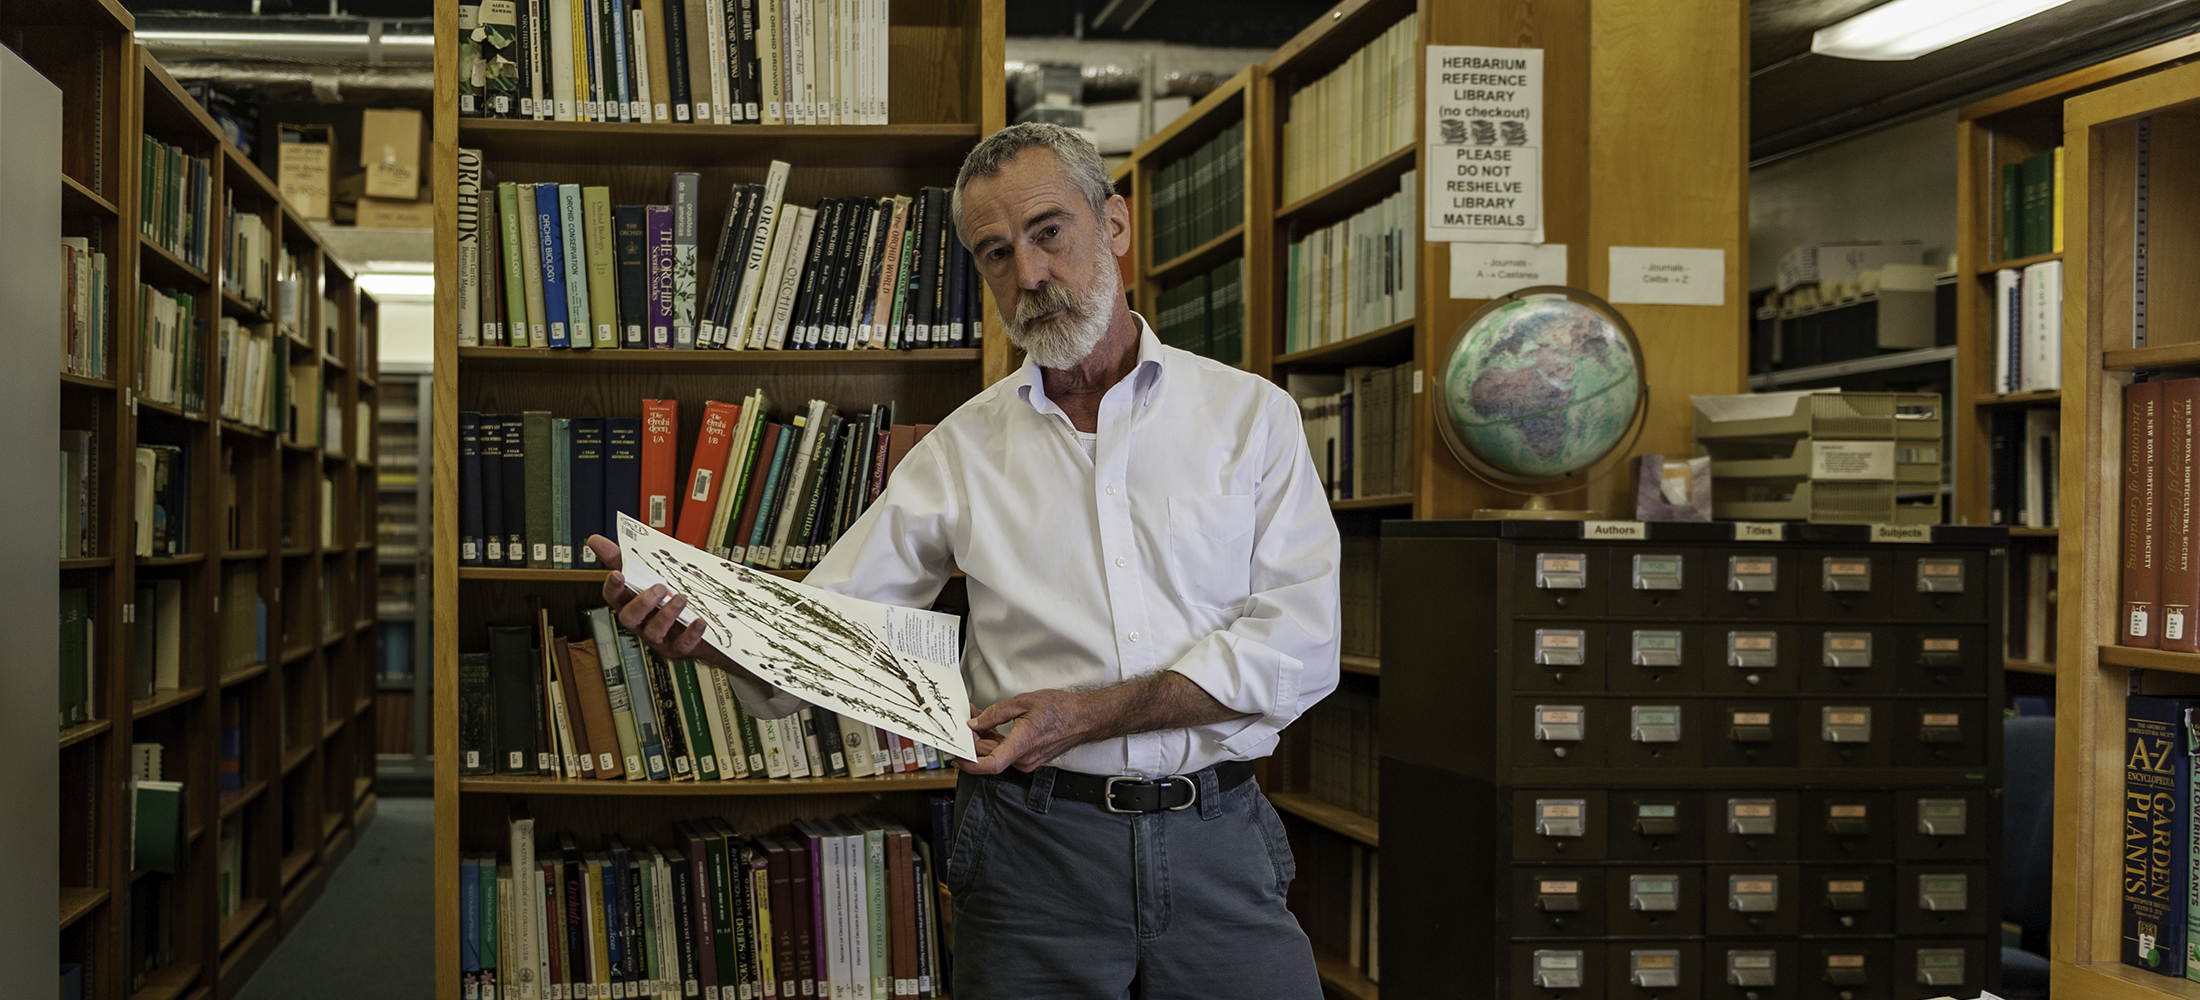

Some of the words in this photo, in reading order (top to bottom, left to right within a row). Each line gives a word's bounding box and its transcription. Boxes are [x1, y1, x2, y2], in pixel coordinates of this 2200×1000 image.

[742, 10, 753, 40] GROWING
[795, 49, 804, 76] Orchids
[1442, 57, 1526, 70] HERBARIUM
[1442, 74, 1527, 86] REFERENCE
[1454, 90, 1515, 102] LIBRARY
[1439, 106, 1462, 118] (no
[1465, 107, 1530, 120] checkout)
[1457, 149, 1512, 161] PLEASE
[1458, 165, 1478, 176] DO
[1482, 166, 1512, 177] NOT
[458, 153, 479, 244] ORCHIDS
[679, 182, 686, 191] de
[1447, 181, 1522, 193] RESHELVE
[566, 195, 574, 221] ORCHID
[832, 203, 844, 225] Growing
[848, 205, 860, 227] Growing
[1453, 198, 1515, 209] LIBRARY
[508, 214, 517, 244] ORCHID
[528, 215, 538, 246] ORCHID
[542, 214, 551, 246] ORCHID
[678, 206, 686, 237] américas
[818, 206, 831, 229] Growing
[892, 216, 902, 228] the
[1443, 214, 1525, 226] MATERIALS
[568, 223, 578, 275] CONSERVATION
[597, 226, 605, 251] Biology
[660, 228, 672, 255] THE
[748, 206, 774, 271] ORCHIDS
[812, 230, 826, 263] ORCHIDS
[826, 226, 839, 256] ORCHIDS
[844, 228, 856, 258] ORCHIDS
[888, 231, 900, 262] ORCHID
[902, 235, 912, 262] ORCHIDS
[461, 246, 469, 277] Botanical
[511, 245, 520, 279] BIOLOGY
[531, 248, 541, 284] BIOLOGY
[545, 247, 555, 283] BIOLOGY
[652, 246, 660, 276] Scientific
[1490, 258, 1526, 268] Journals
[652, 276, 660, 301] Studies
[660, 257, 672, 316] ORCHIDS
[882, 264, 894, 294] WORLD
[898, 271, 908, 296] COLOUR
[648, 418, 670, 426] Orchi
[648, 425, 671, 434] deen
[706, 419, 727, 428] Orchi
[706, 427, 726, 437] deen
[812, 432, 826, 462] Orchids
[2129, 403, 2144, 477] Dictionary
[2168, 400, 2184, 477] Dictionary
[772, 456, 782, 476] NAMES
[2129, 480, 2144, 495] of
[2167, 480, 2182, 495] of
[2182, 466, 2191, 534] HORTICULTURAL
[759, 485, 774, 522] ORCHIDS
[802, 494, 820, 537] ORCHIDS
[1595, 526, 1636, 535] Authors
[1746, 526, 1773, 536] Titles
[1879, 527, 1922, 538] Subjects
[2127, 496, 2143, 570] Gardening
[2165, 497, 2182, 572] Gardening
[722, 678, 727, 688] OF
[556, 702, 567, 730] ORCHIDS
[716, 683, 725, 706] ORCHID
[722, 707, 734, 748] CONFERENCE,
[2127, 737, 2175, 776] A-Z
[2128, 772, 2175, 787] ENCYCLOPEDIA
[731, 847, 738, 857] AN
[2124, 789, 2152, 895] PLANTS
[2150, 792, 2176, 902] GARDEN
[732, 858, 741, 898] INTRODUCTION
[874, 858, 882, 887] NATIVE
[2192, 858, 2200, 906] PLANTS
[522, 898, 528, 907] OF
[568, 881, 580, 924] Orchids
[633, 885, 641, 902] Wild
[874, 888, 883, 921] ORCHIDS
[634, 902, 642, 927] Orchids
[876, 923, 882, 932] OF
[736, 918, 747, 952] ORCHIDS
[637, 937, 645, 971] CALIFORNIA
